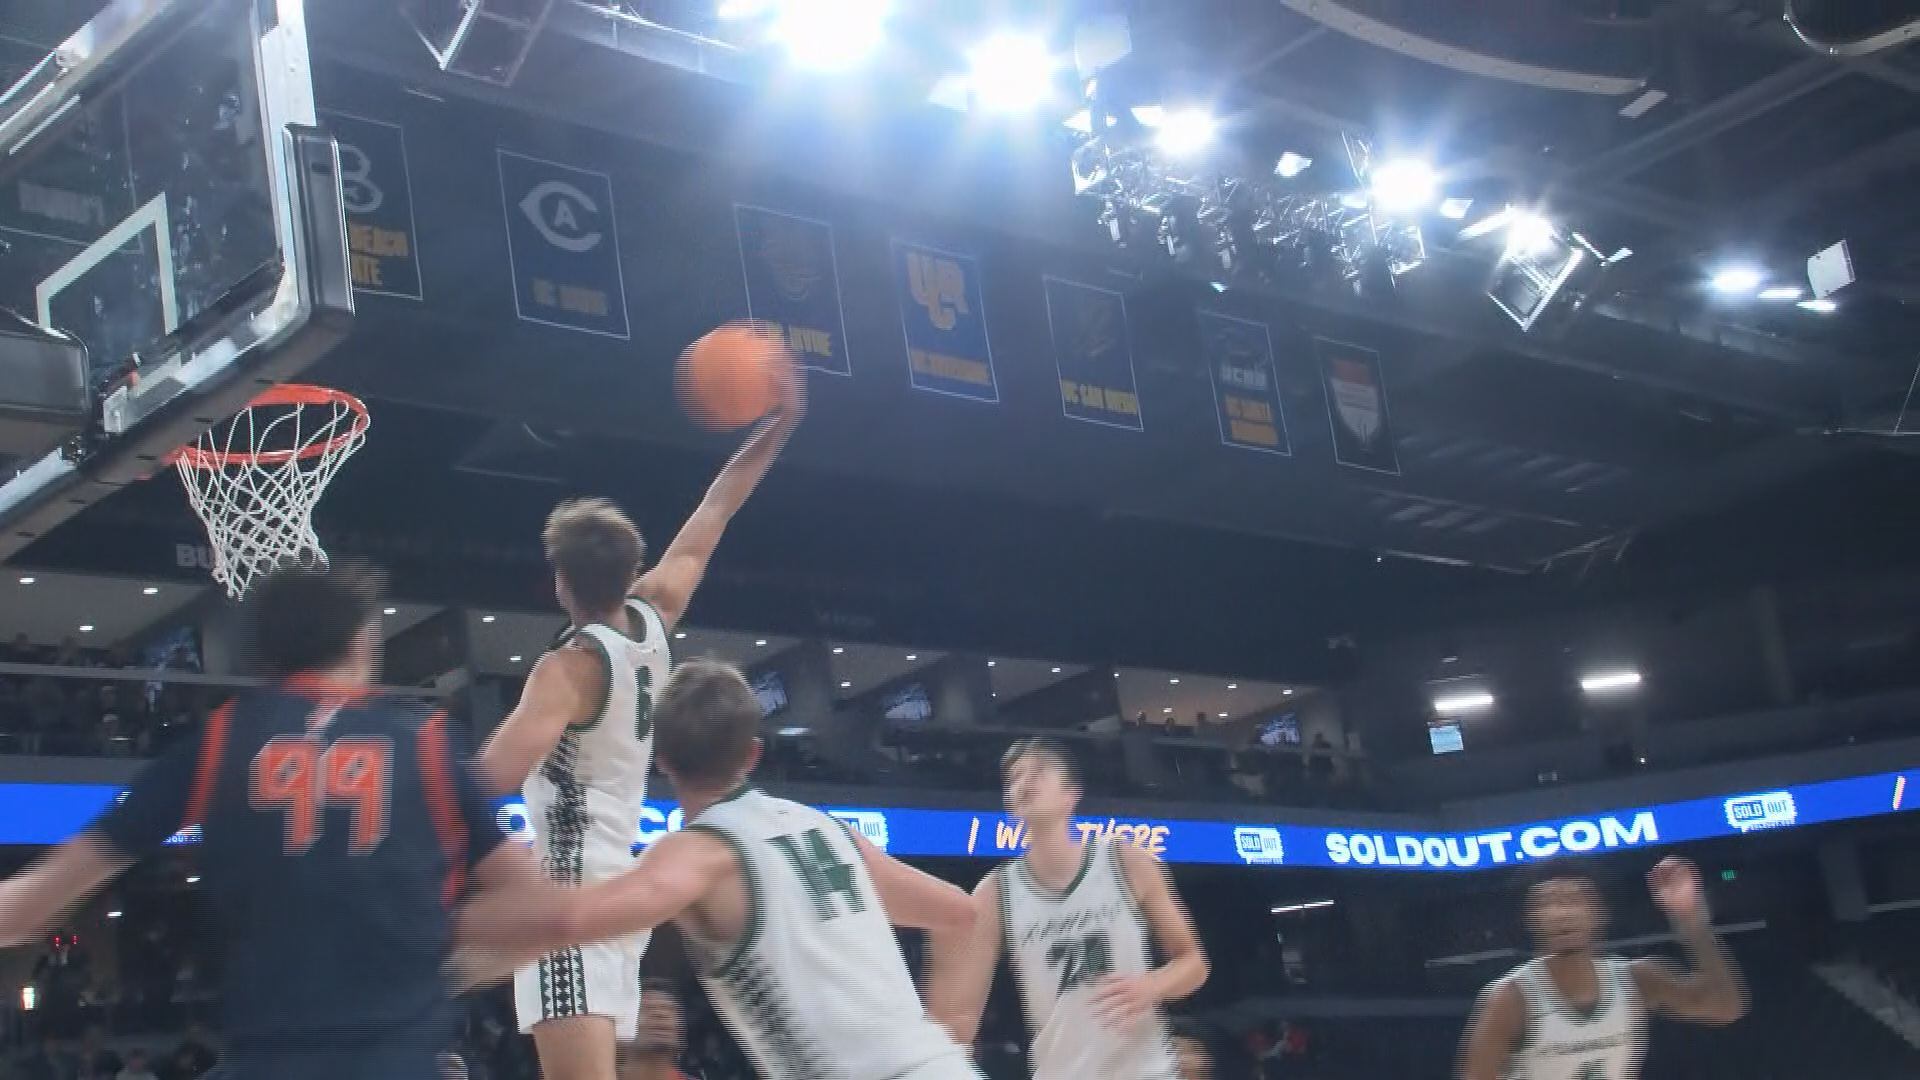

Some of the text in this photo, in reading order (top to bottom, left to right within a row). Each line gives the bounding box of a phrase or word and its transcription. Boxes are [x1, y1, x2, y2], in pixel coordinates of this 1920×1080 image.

[248, 735, 394, 857] 99
[1735, 799, 1787, 818] SOLD OUT
[764, 828, 868, 922] 14
[1326, 812, 1658, 867] SOLDOUT.COM
